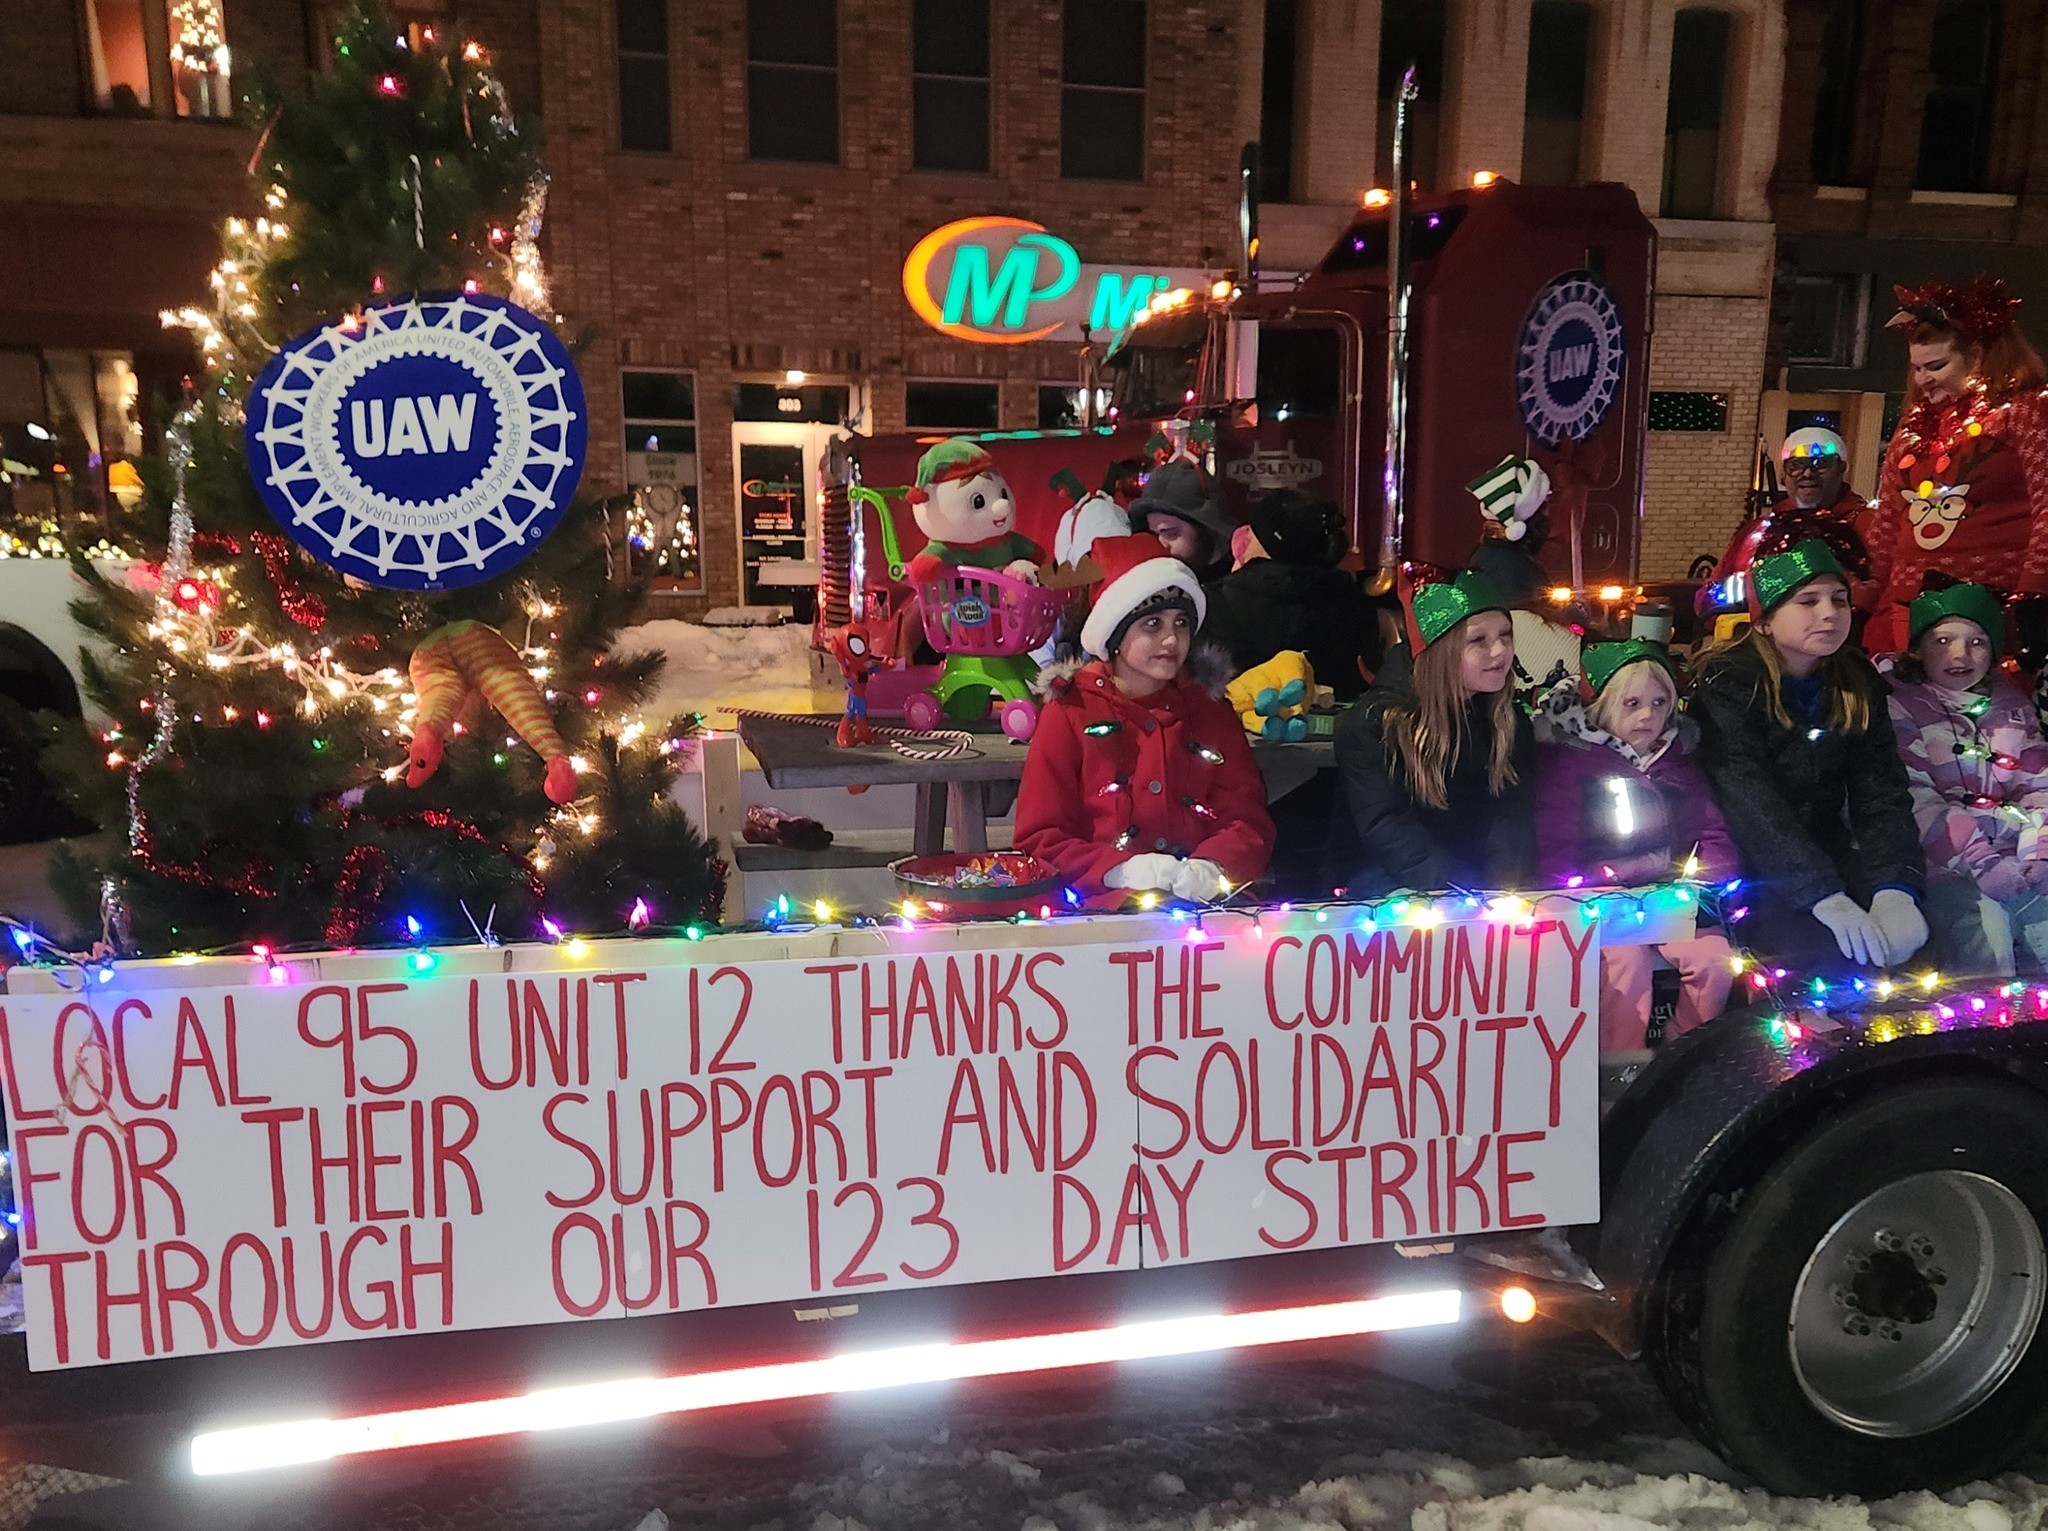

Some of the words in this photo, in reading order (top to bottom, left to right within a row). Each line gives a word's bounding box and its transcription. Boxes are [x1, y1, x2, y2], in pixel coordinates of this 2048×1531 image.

[417, 334, 466, 351] UNITED
[1550, 342, 1594, 383] UAW
[351, 393, 477, 458] UAW
[486, 421, 521, 494] AEROSPACE
[311, 435, 357, 504] IMPLEMENT
[461, 490, 488, 515] AND
[359, 499, 459, 527] AGRICULTURAL
[0, 994, 271, 1121] LOCAL
[298, 983, 417, 1097] 95
[469, 973, 647, 1091] UNIT
[689, 966, 756, 1075] 12
[804, 952, 1068, 1063] THANKS
[1109, 943, 1225, 1045] THE
[1264, 920, 1596, 1030] COMMUNITY
[15, 1118, 186, 1249] FOR
[241, 1095, 483, 1227] THEIR
[542, 1067, 893, 1208] SUPPORT
[937, 1051, 1097, 1175] AND
[1125, 1012, 1587, 1160] SOLIDARITY
[22, 1221, 453, 1364] THROUGH
[552, 1200, 718, 1317] OUR
[807, 1177, 959, 1291] 123
[1053, 1159, 1204, 1272] DAY
[1258, 1131, 1546, 1249] STRIKE
